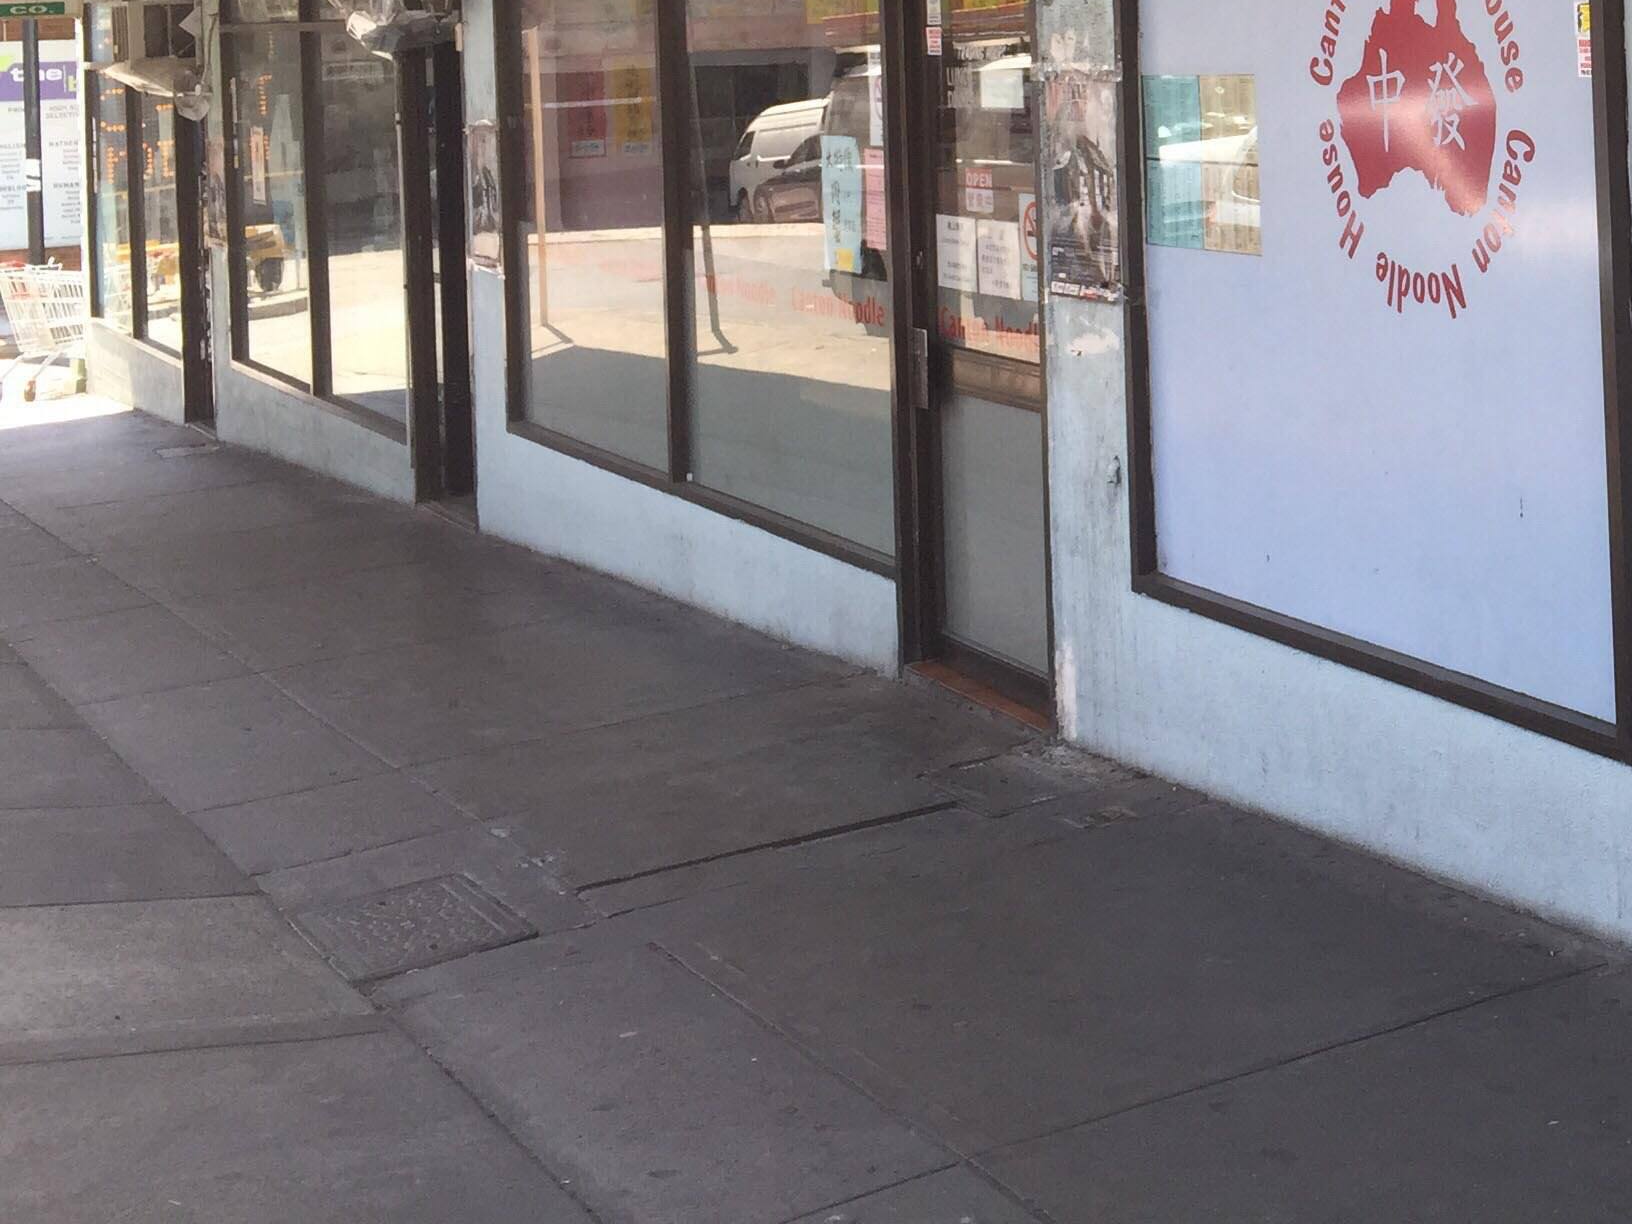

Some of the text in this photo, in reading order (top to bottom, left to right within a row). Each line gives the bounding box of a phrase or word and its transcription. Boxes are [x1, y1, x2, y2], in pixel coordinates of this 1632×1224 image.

[1366, 48, 1479, 152] 中發
[1318, 118, 1365, 259] House
[1472, 129, 1535, 273] Canton
[838, 292, 885, 326] Noodle
[1376, 251, 1467, 319] Noodle
